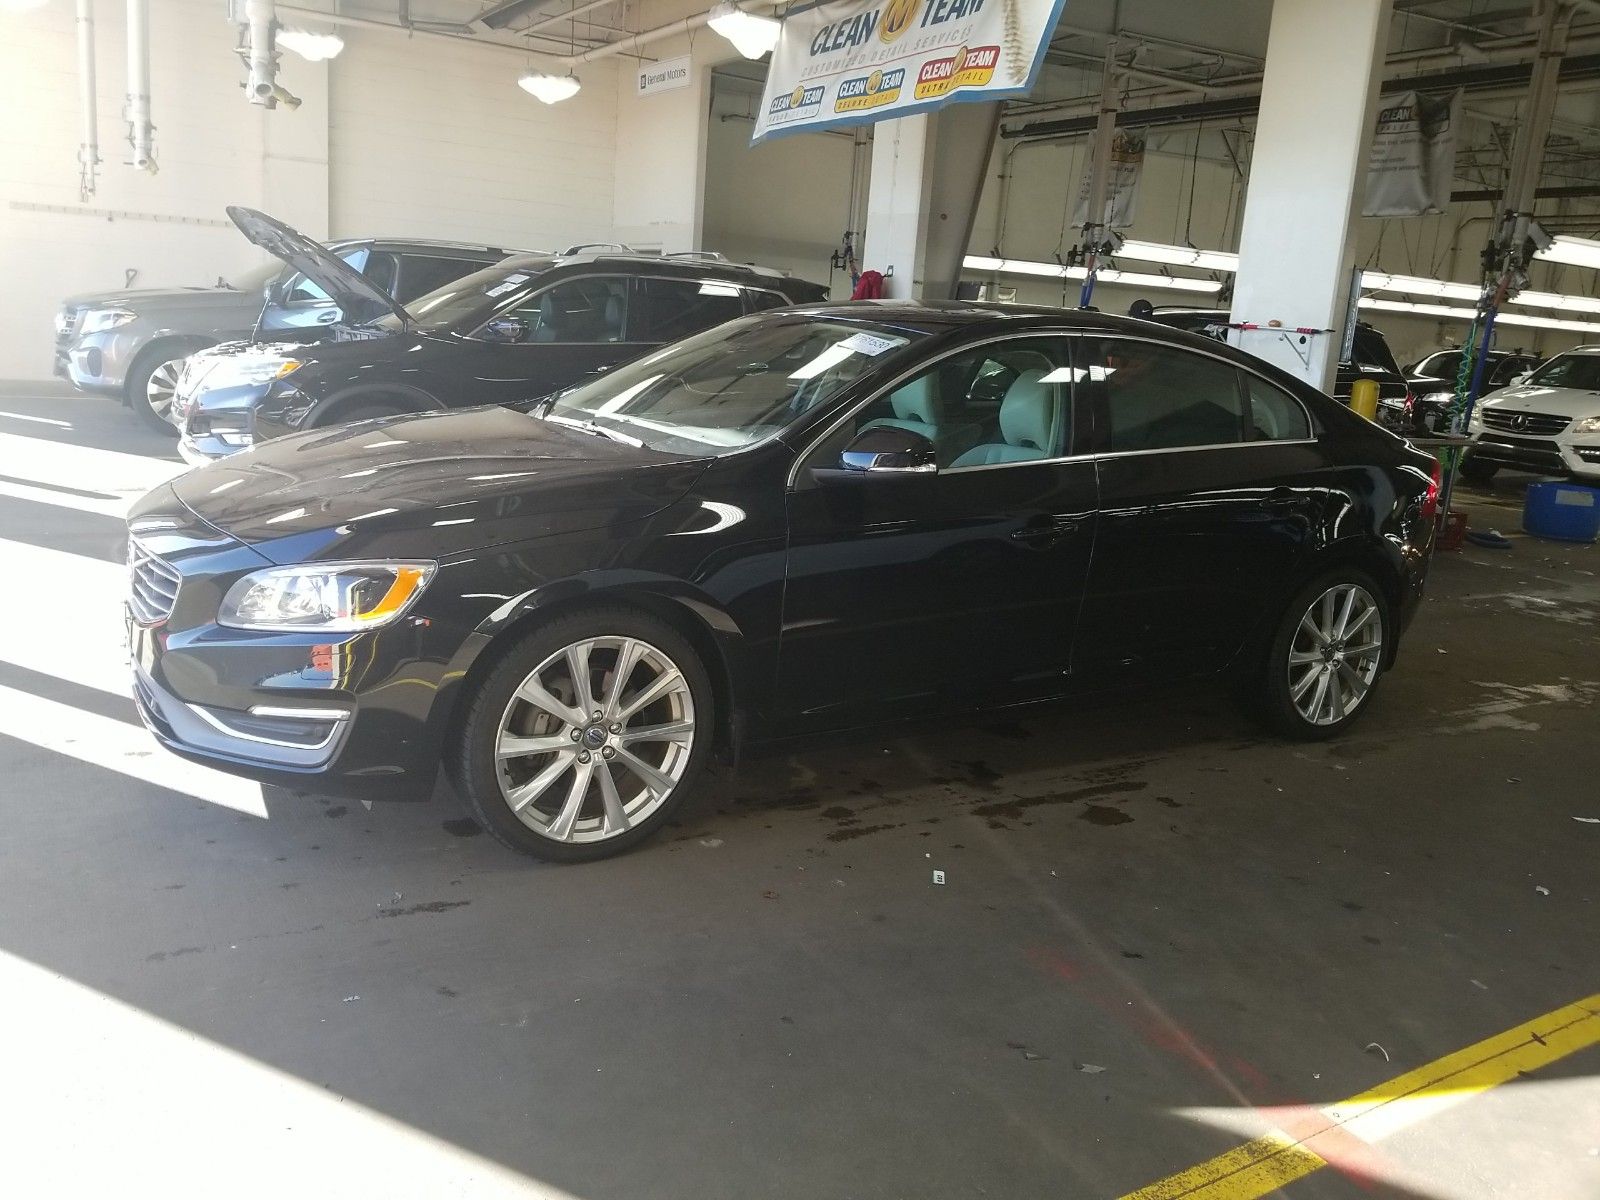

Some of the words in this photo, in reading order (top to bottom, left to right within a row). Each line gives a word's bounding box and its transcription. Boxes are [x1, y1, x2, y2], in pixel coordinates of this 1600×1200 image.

[810, 9, 880, 57] CLEAN
[920, 0, 985, 28] TEAM
[871, 41, 908, 62] DETAIL
[914, 24, 973, 50] SERVICES
[647, 71, 666, 85] General
[667, 69, 687, 80] Motors
[922, 61, 954, 80] CLEAN
[964, 50, 996, 68] TEAM
[840, 79, 867, 97] CLEAN
[880, 71, 903, 90] TEAM
[770, 94, 792, 112] CLEAN
[802, 88, 824, 105] TEAM
[1381, 108, 1410, 121] CLEAN
